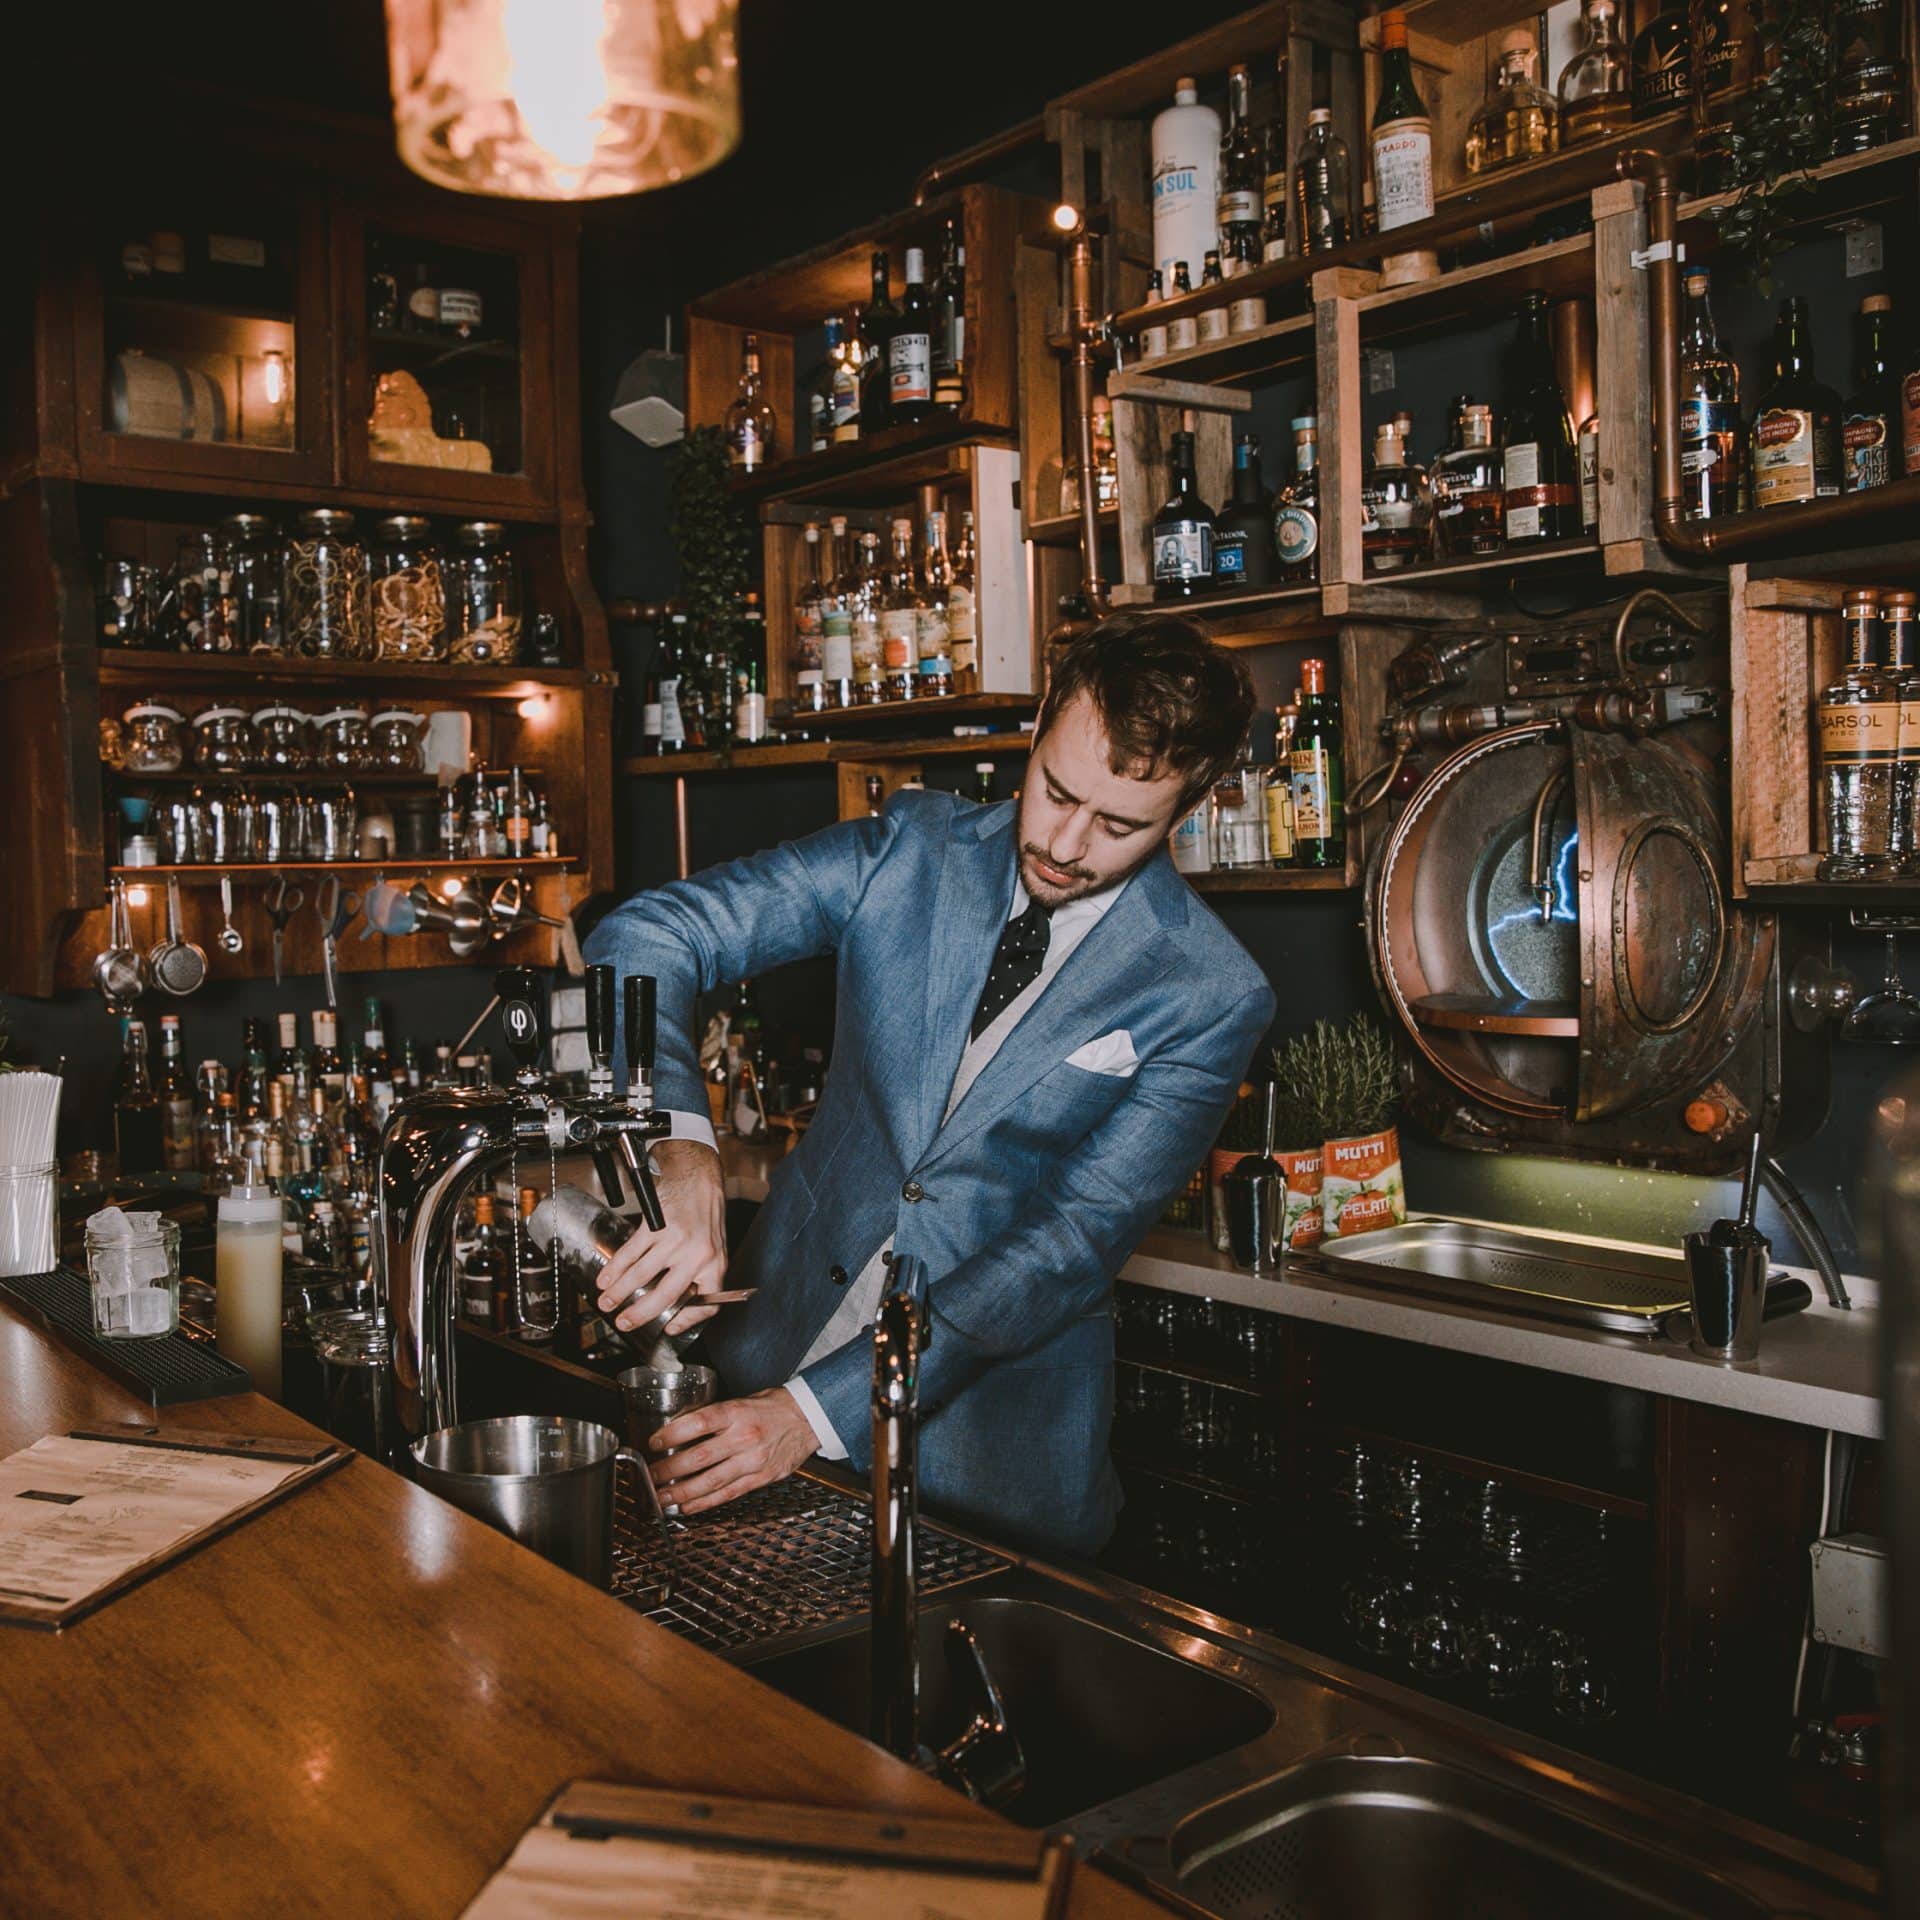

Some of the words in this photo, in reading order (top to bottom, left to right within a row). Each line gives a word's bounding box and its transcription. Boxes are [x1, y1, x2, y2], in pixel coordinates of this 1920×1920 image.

[1375, 140, 1417, 156] UXARDO
[1166, 173, 1198, 193] SUL
[1220, 554, 1236, 568] 20
[1821, 714, 1883, 729] BARSOL
[1335, 1141, 1385, 1161] MUTTI
[1294, 1158, 1322, 1174] MUT
[1342, 1198, 1390, 1216] PELATI
[1295, 1216, 1321, 1233] PEL
